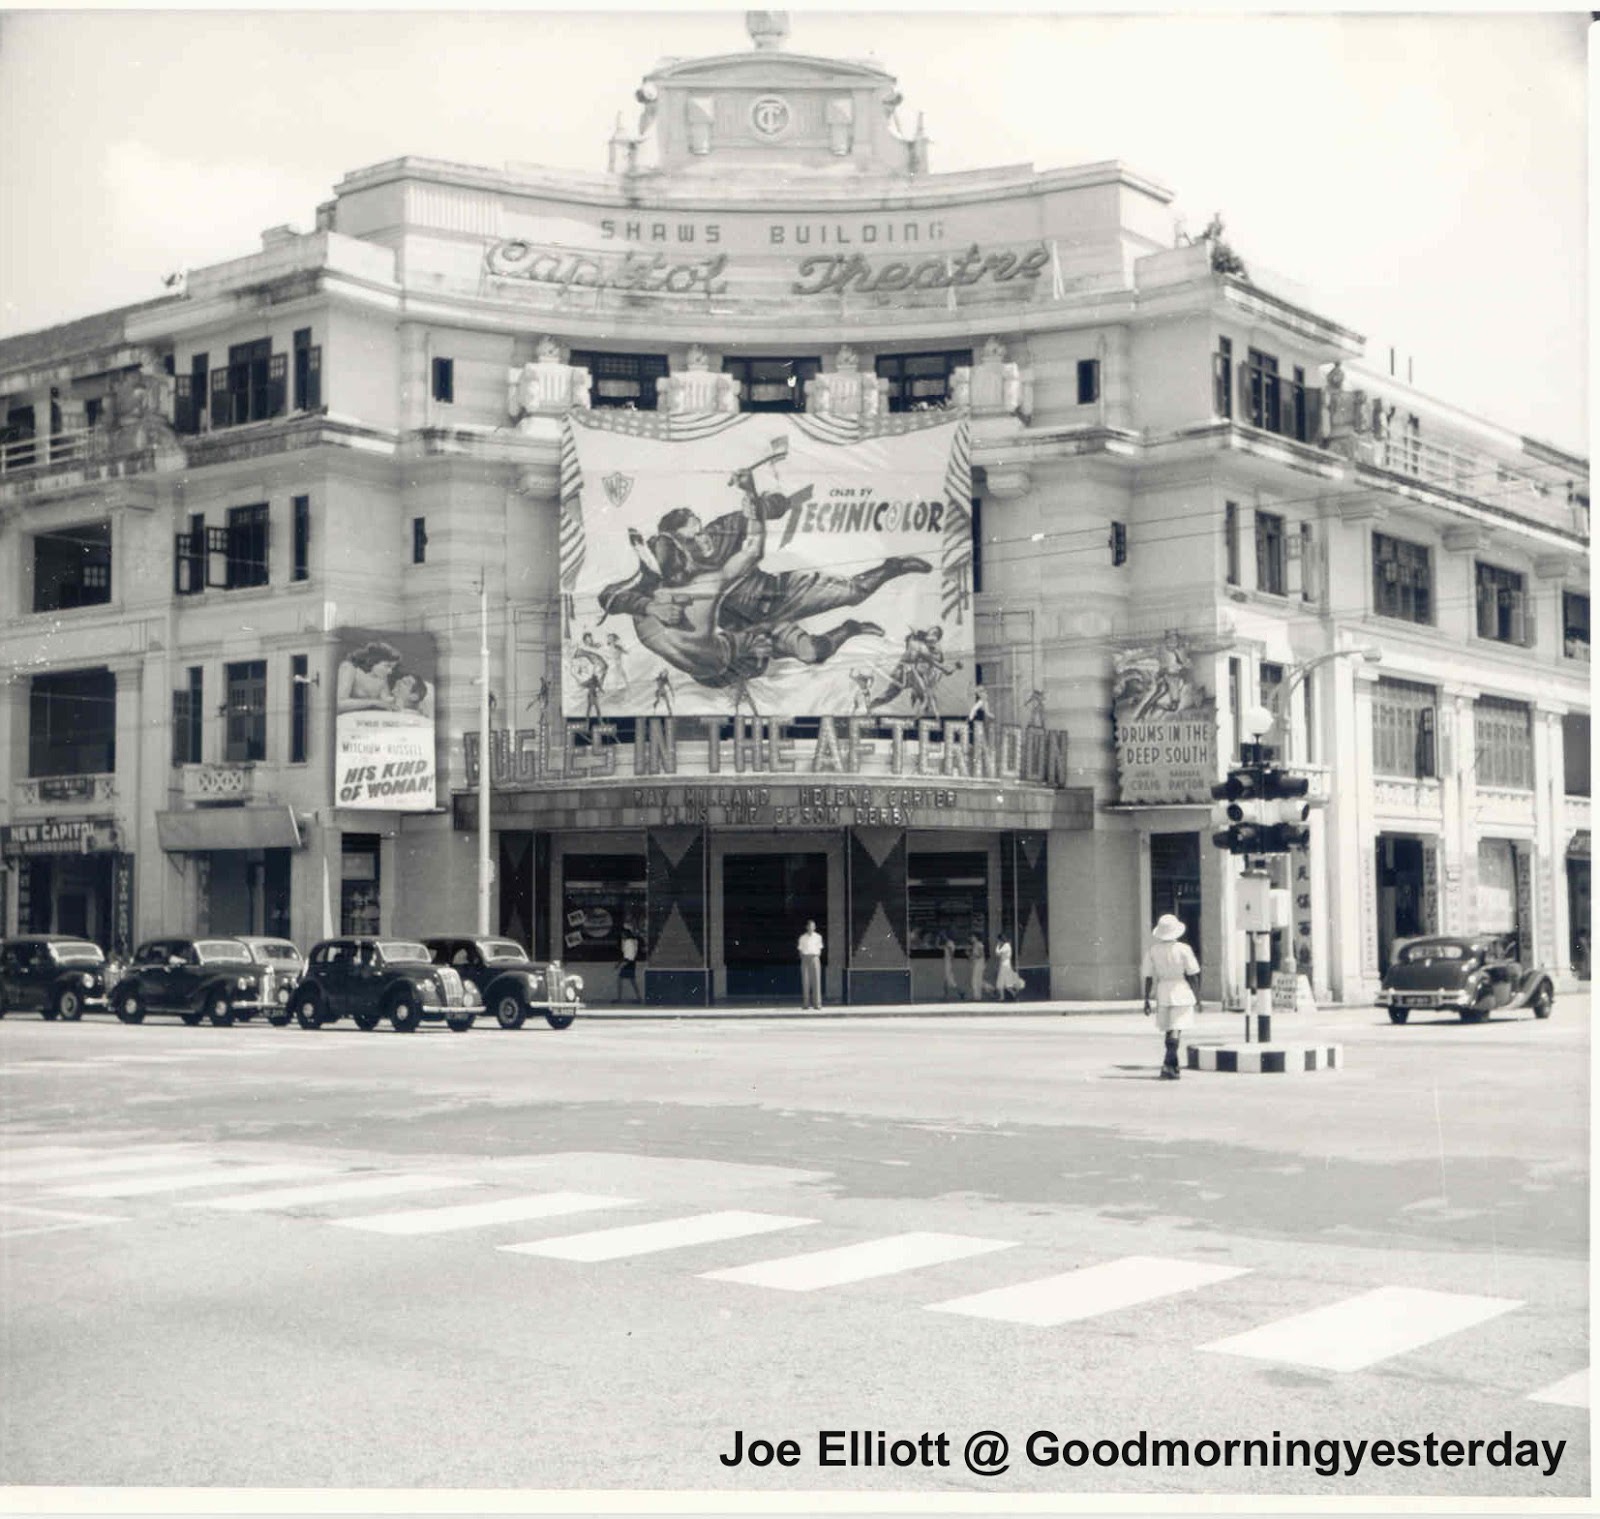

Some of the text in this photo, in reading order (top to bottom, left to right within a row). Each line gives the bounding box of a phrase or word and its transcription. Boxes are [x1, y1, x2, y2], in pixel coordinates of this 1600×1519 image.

[601, 220, 944, 244] SHAWS BUILDING
[486, 241, 1050, 297] Capitol Theatre
[860, 488, 873, 497] BY
[780, 484, 944, 548] TECHNICOLOR
[1121, 725, 1208, 742] DRUMS IN THE
[463, 716, 1069, 788] BUGLES IN THE AFTERNOON
[1127, 745, 1207, 765] DEEP SOUTH
[344, 760, 428, 784] HIS KIND
[339, 785, 363, 802] OF
[800, 788, 872, 806] HELENA
[888, 789, 957, 808] CARTER
[726, 807, 757, 824] THE
[10, 821, 94, 842] NEW CAPITOL
